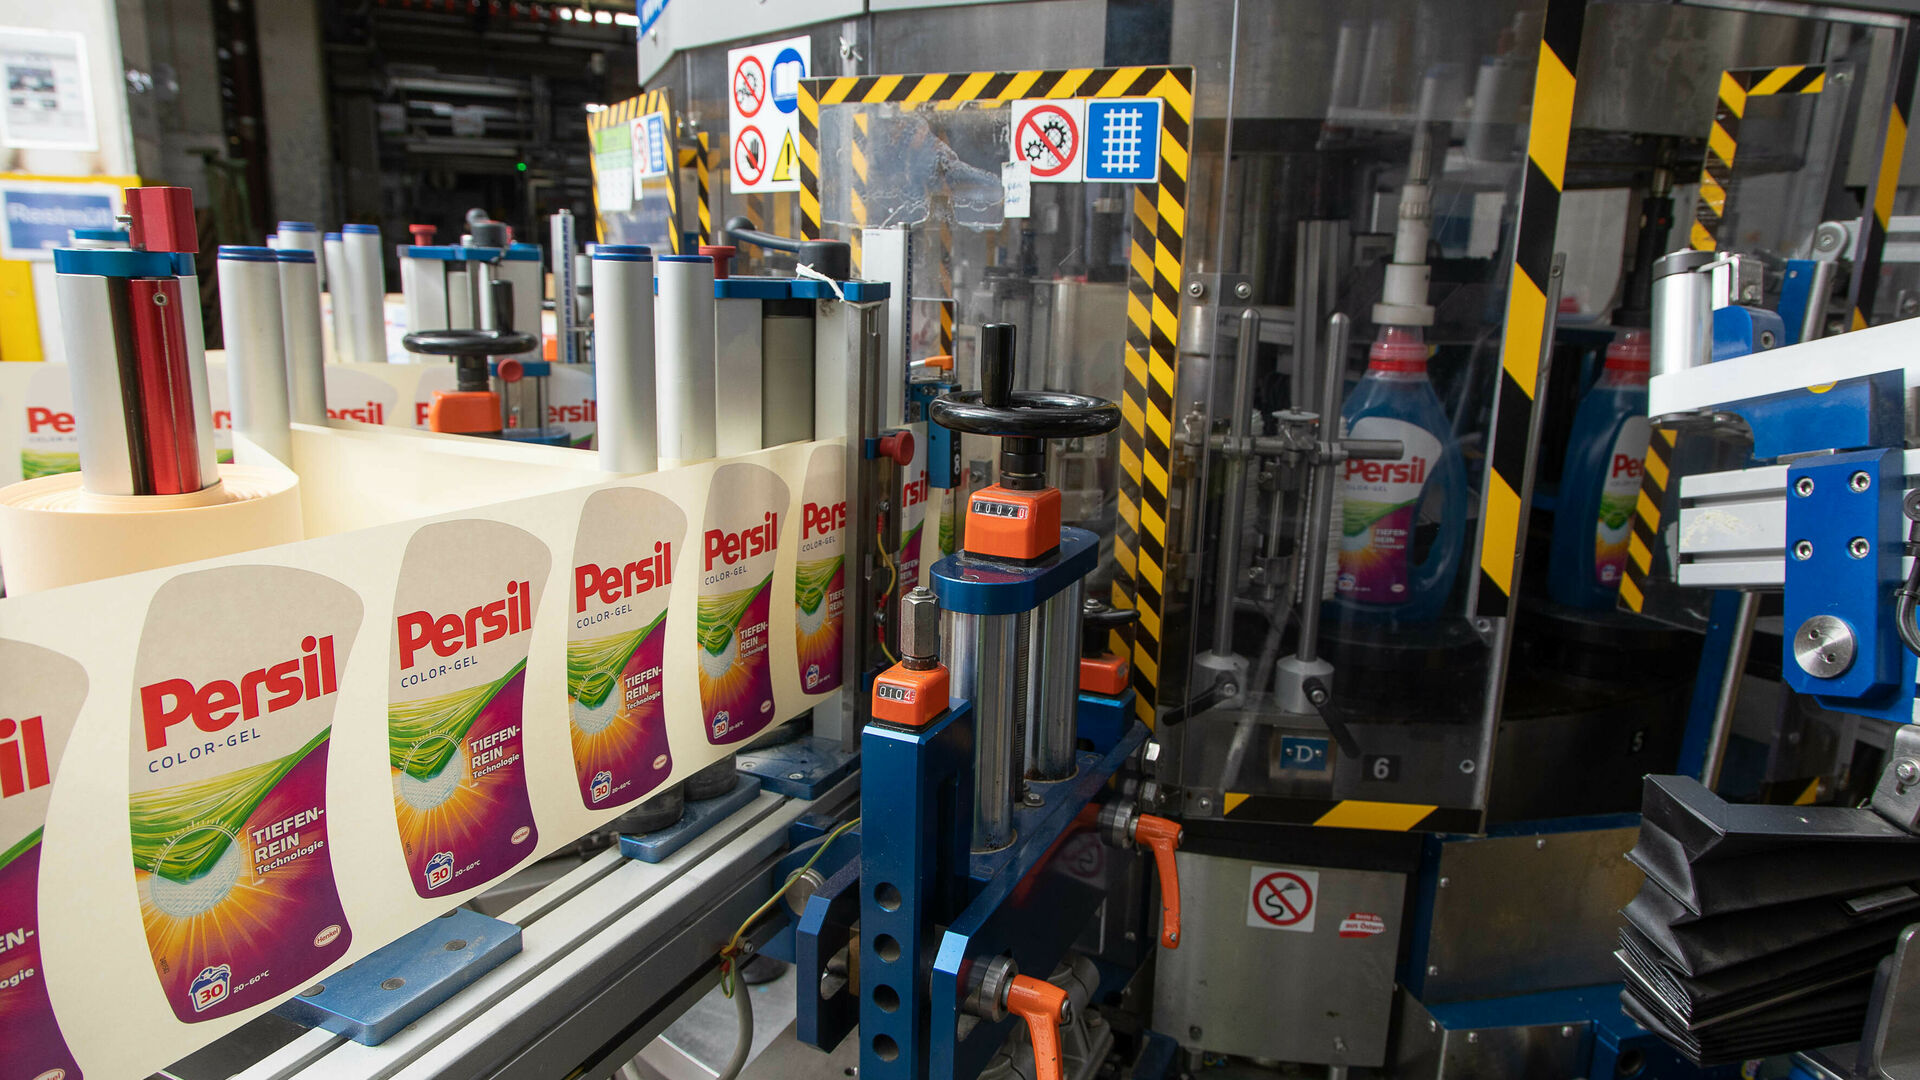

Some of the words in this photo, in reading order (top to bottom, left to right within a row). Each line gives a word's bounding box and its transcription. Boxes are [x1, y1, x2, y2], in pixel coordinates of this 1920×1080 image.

[1345, 456, 1426, 484] Persil
[704, 511, 778, 572] Persil
[802, 536, 836, 552] COLOR-GEL
[575, 540, 672, 614] Persil
[705, 567, 748, 586] COLOR-GEL
[397, 580, 532, 671] Persil
[576, 604, 633, 629] COLOR-GEL
[740, 621, 768, 640] TIEFEN-
[740, 636, 759, 651] REIN
[401, 655, 479, 688] COLOR-GEL
[625, 665, 662, 688] TIEFEN-
[140, 634, 338, 752] Persil
[625, 683, 649, 702] REIN
[626, 691, 661, 710] Technologie
[470, 725, 520, 754] TIEFEN-
[716, 725, 726, 734] 30
[148, 727, 261, 773] COLOR-GEL
[471, 745, 503, 769] REIN
[1295, 745, 1314, 763] D
[472, 753, 520, 779] Technologie
[1373, 757, 1390, 779] 6
[595, 784, 608, 798] 30
[252, 806, 325, 845] TIEFEN-
[254, 832, 300, 864] REIN
[256, 840, 324, 875] Technologie
[432, 867, 449, 884] 30
[317, 928, 340, 944] Henkel
[200, 983, 224, 1004] 30
